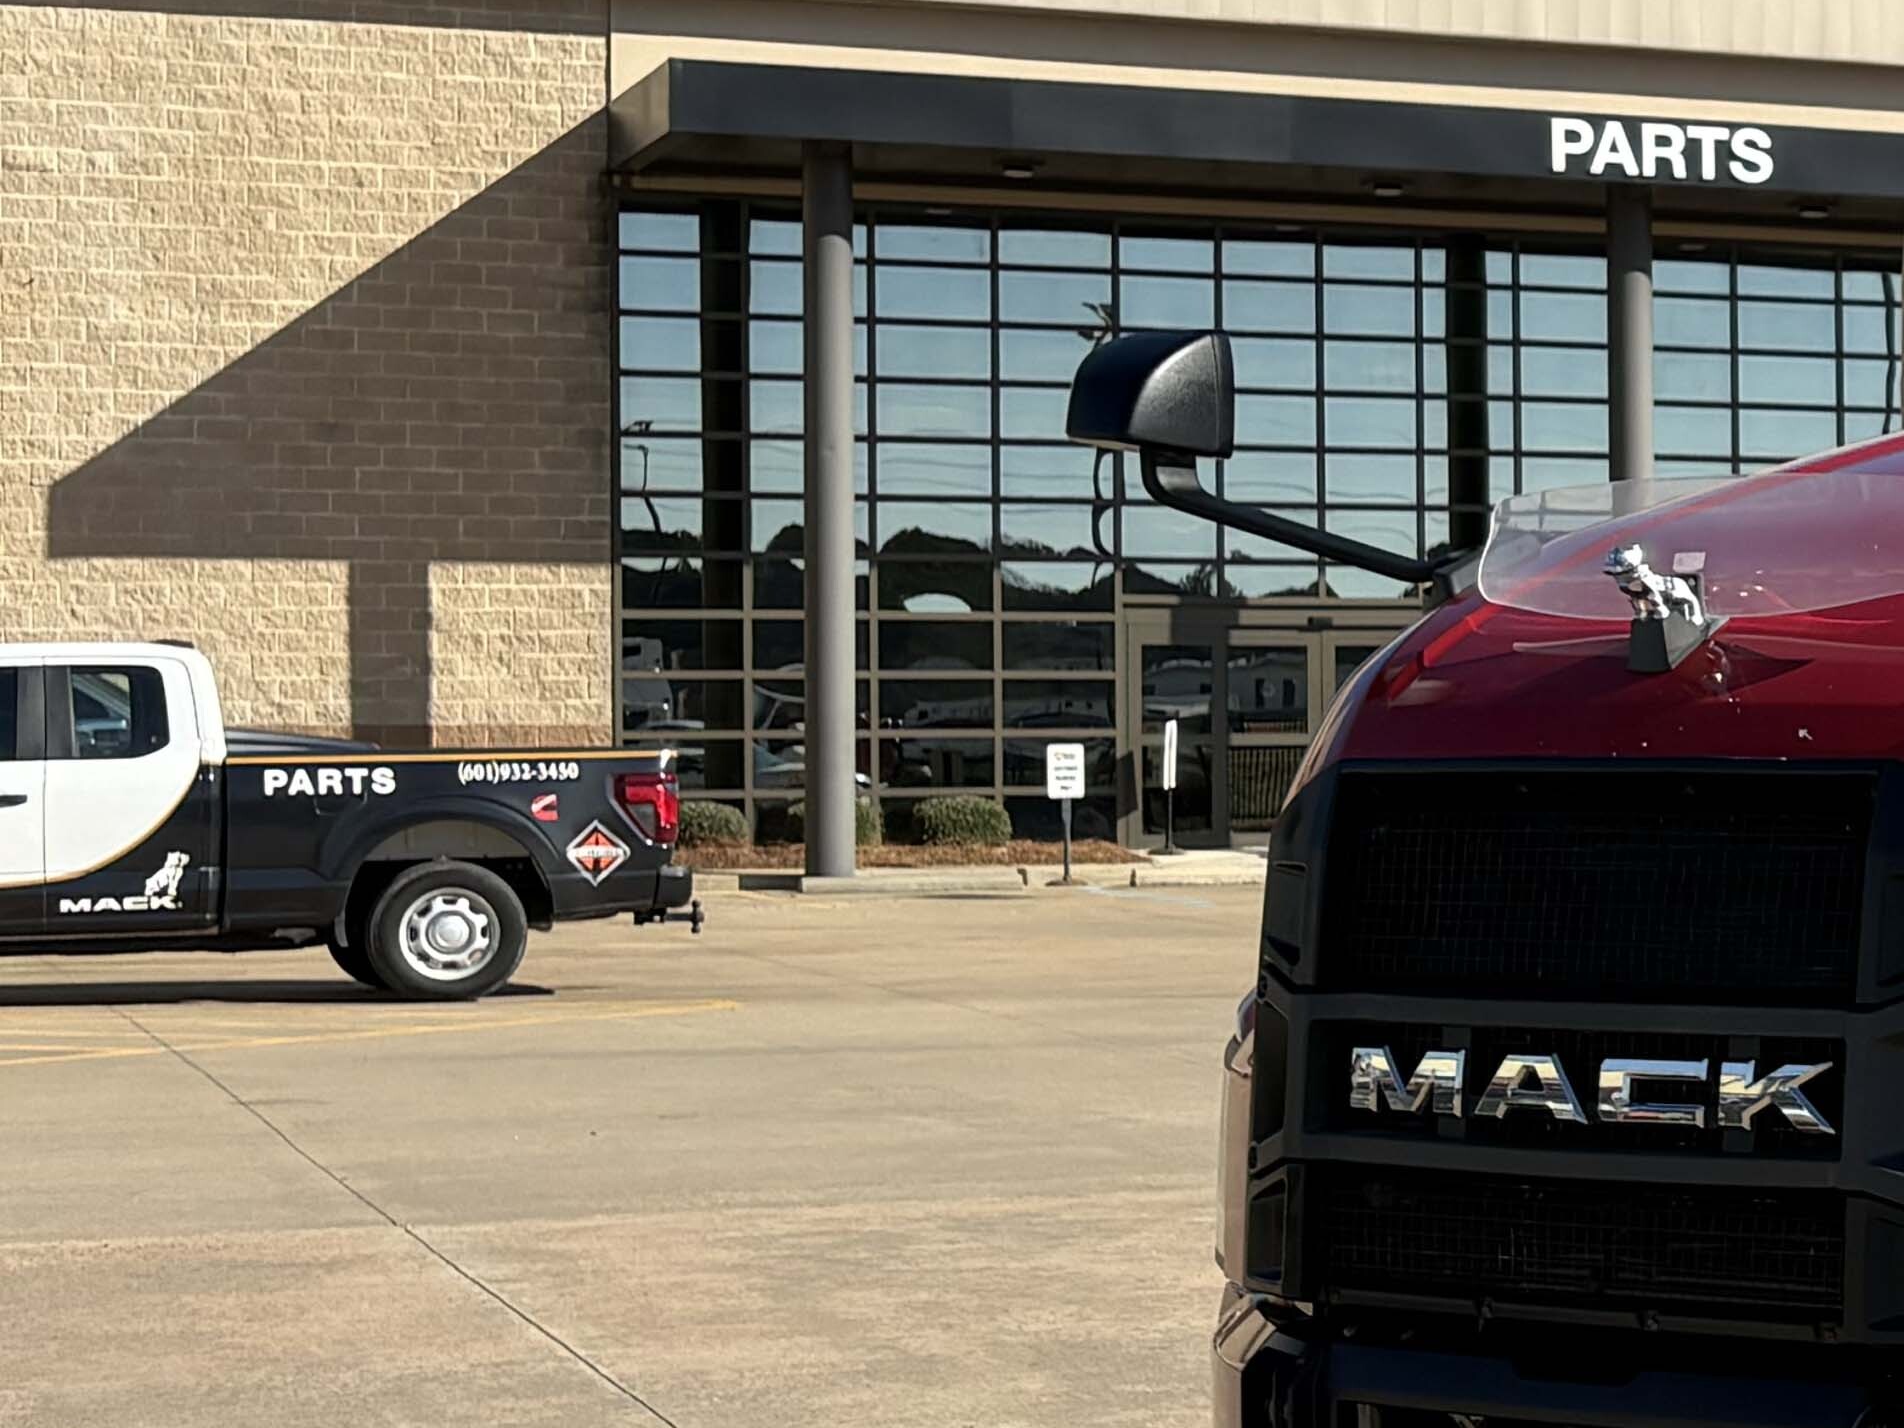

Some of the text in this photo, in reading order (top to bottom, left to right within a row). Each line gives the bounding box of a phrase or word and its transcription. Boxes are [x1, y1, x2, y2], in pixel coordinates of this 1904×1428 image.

[1551, 117, 1775, 184] PARTS
[263, 766, 397, 797] PARTS
[59, 895, 177, 913] MACK
[1350, 1044, 1836, 1136] MACK
